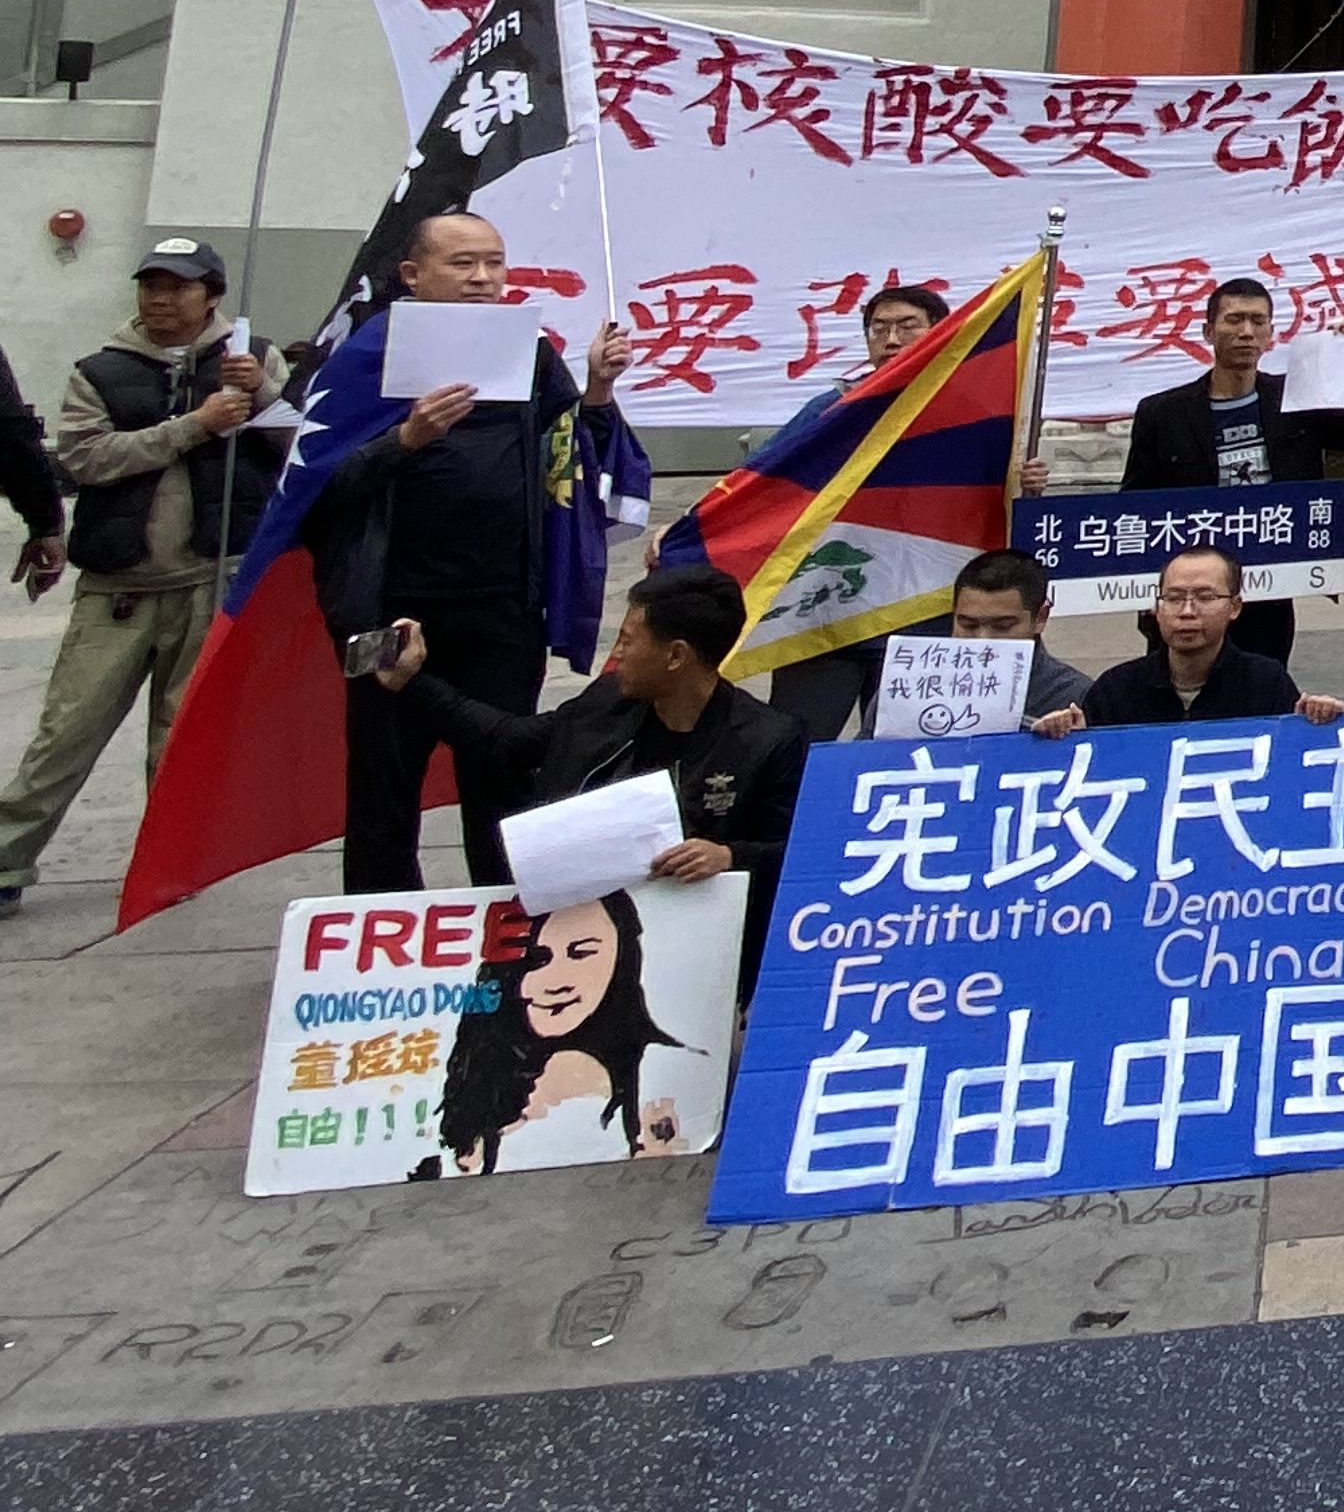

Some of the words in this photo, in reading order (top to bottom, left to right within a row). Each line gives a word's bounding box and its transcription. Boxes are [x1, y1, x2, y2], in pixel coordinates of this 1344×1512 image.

[1034, 514, 1063, 543] 北
[1073, 503, 1296, 558] 乌鲁木齐中路
[1308, 498, 1334, 527] 南
[1308, 528, 1331, 550] 88
[1309, 566, 1326, 589] S
[893, 642, 1000, 671] 与你抗争
[888, 671, 1001, 700] 我很愉快
[303, 899, 534, 975] FREE
[787, 894, 1114, 954] Constitution
[294, 985, 428, 1032] QIONGYAO
[821, 953, 1006, 1034] Free
[100, 1310, 352, 1365] R2D2
